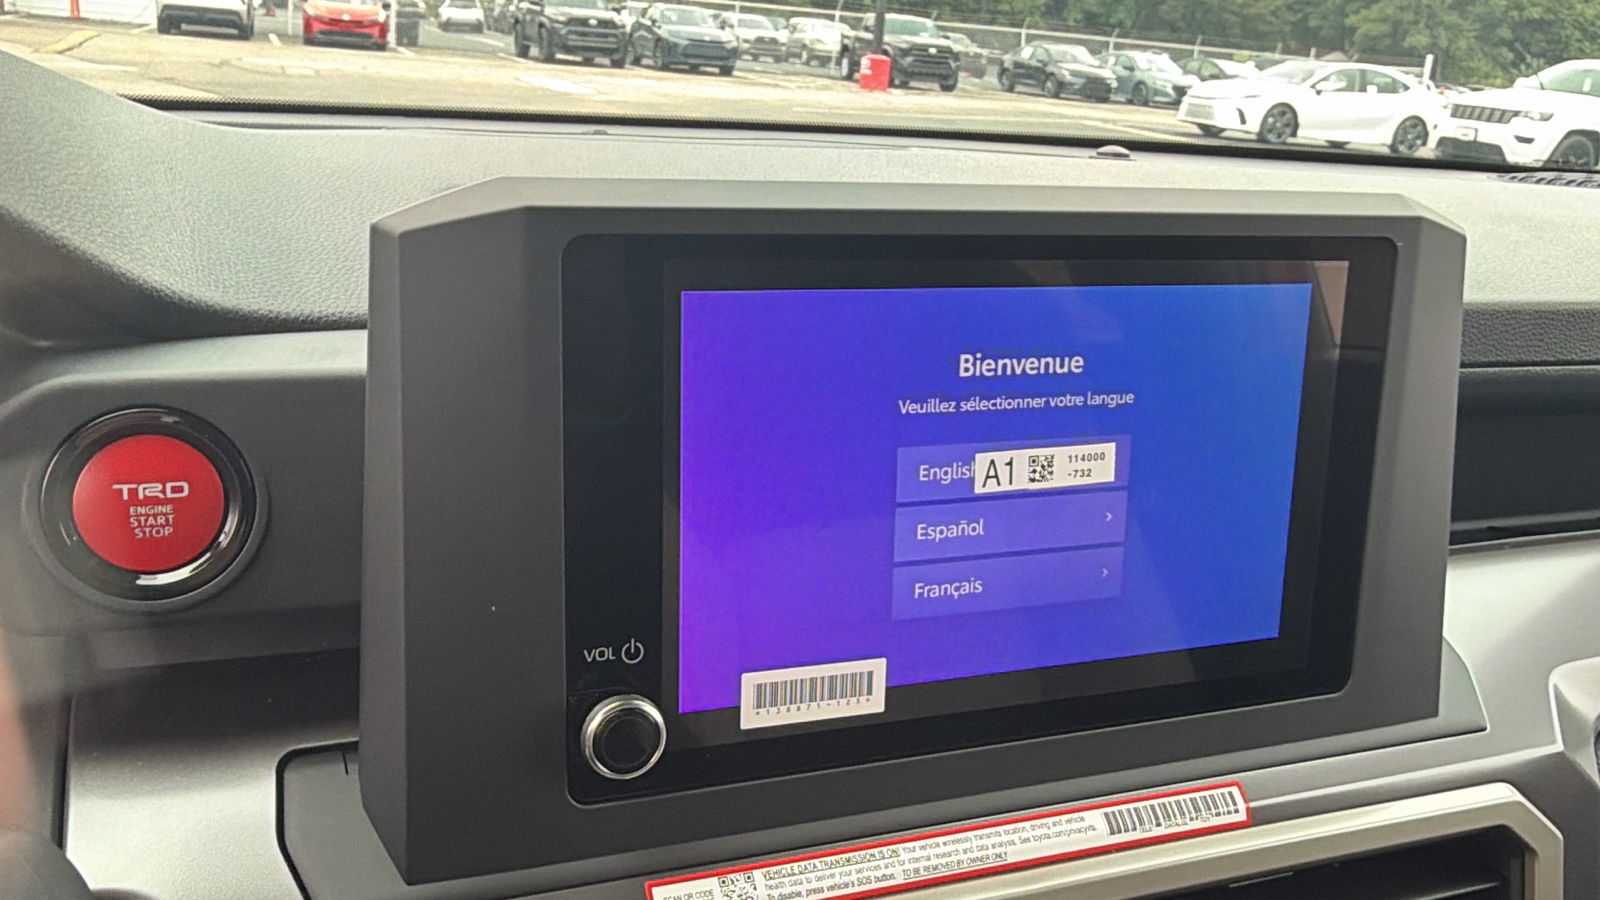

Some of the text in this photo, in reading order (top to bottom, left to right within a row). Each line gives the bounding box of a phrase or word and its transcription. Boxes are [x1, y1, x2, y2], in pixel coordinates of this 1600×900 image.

[958, 352, 1084, 377] Bienvenue
[899, 391, 1134, 414] Veuillez sélectionner votre langue
[1067, 452, 1106, 464] 114000
[982, 457, 1014, 488] A1
[1067, 468, 1092, 478] -732
[112, 481, 190, 500] TRD
[129, 504, 174, 515] ENGINE
[130, 514, 175, 527] START
[916, 518, 985, 542] Español
[134, 526, 173, 538] STOP
[914, 577, 983, 599] Français
[583, 647, 616, 662] VOL
[761, 865, 796, 880] VEHICLE
[797, 862, 818, 873] DATA
[820, 852, 876, 869] TRANSMISSION
[878, 849, 885, 859] IS
[901, 845, 917, 854] Your
[918, 841, 940, 851] vehicle
[942, 835, 973, 847] wirelessly
[973, 830, 1002, 841] transmits
[1030, 821, 1051, 831] driving
[1052, 818, 1063, 827] and
[1065, 815, 1086, 825] vehicle
[764, 880, 787, 891] health
[788, 877, 803, 887] data
[805, 875, 812, 884] to
[814, 871, 836, 882] deliver
[838, 869, 853, 880] your
[855, 863, 882, 874] services
[884, 858, 896, 868] and
[897, 857, 906, 866] for
[908, 853, 932, 865] internal
[932, 848, 961, 860] research
[962, 845, 974, 855] and
[975, 842, 989, 852] data
[1018, 835, 1032, 845] See
[805, 886, 825, 898] press
[826, 880, 855, 892] vehicle's
[856, 875, 873, 886] SOS
[902, 869, 912, 878] TO
[912, 866, 922, 876] BE
[922, 861, 956, 873] REMOVED
[956, 859, 965, 868] BY
[966, 853, 991, 865] OWNER
[991, 850, 1008, 861] ONLY
[695, 888, 714, 899] CODE
